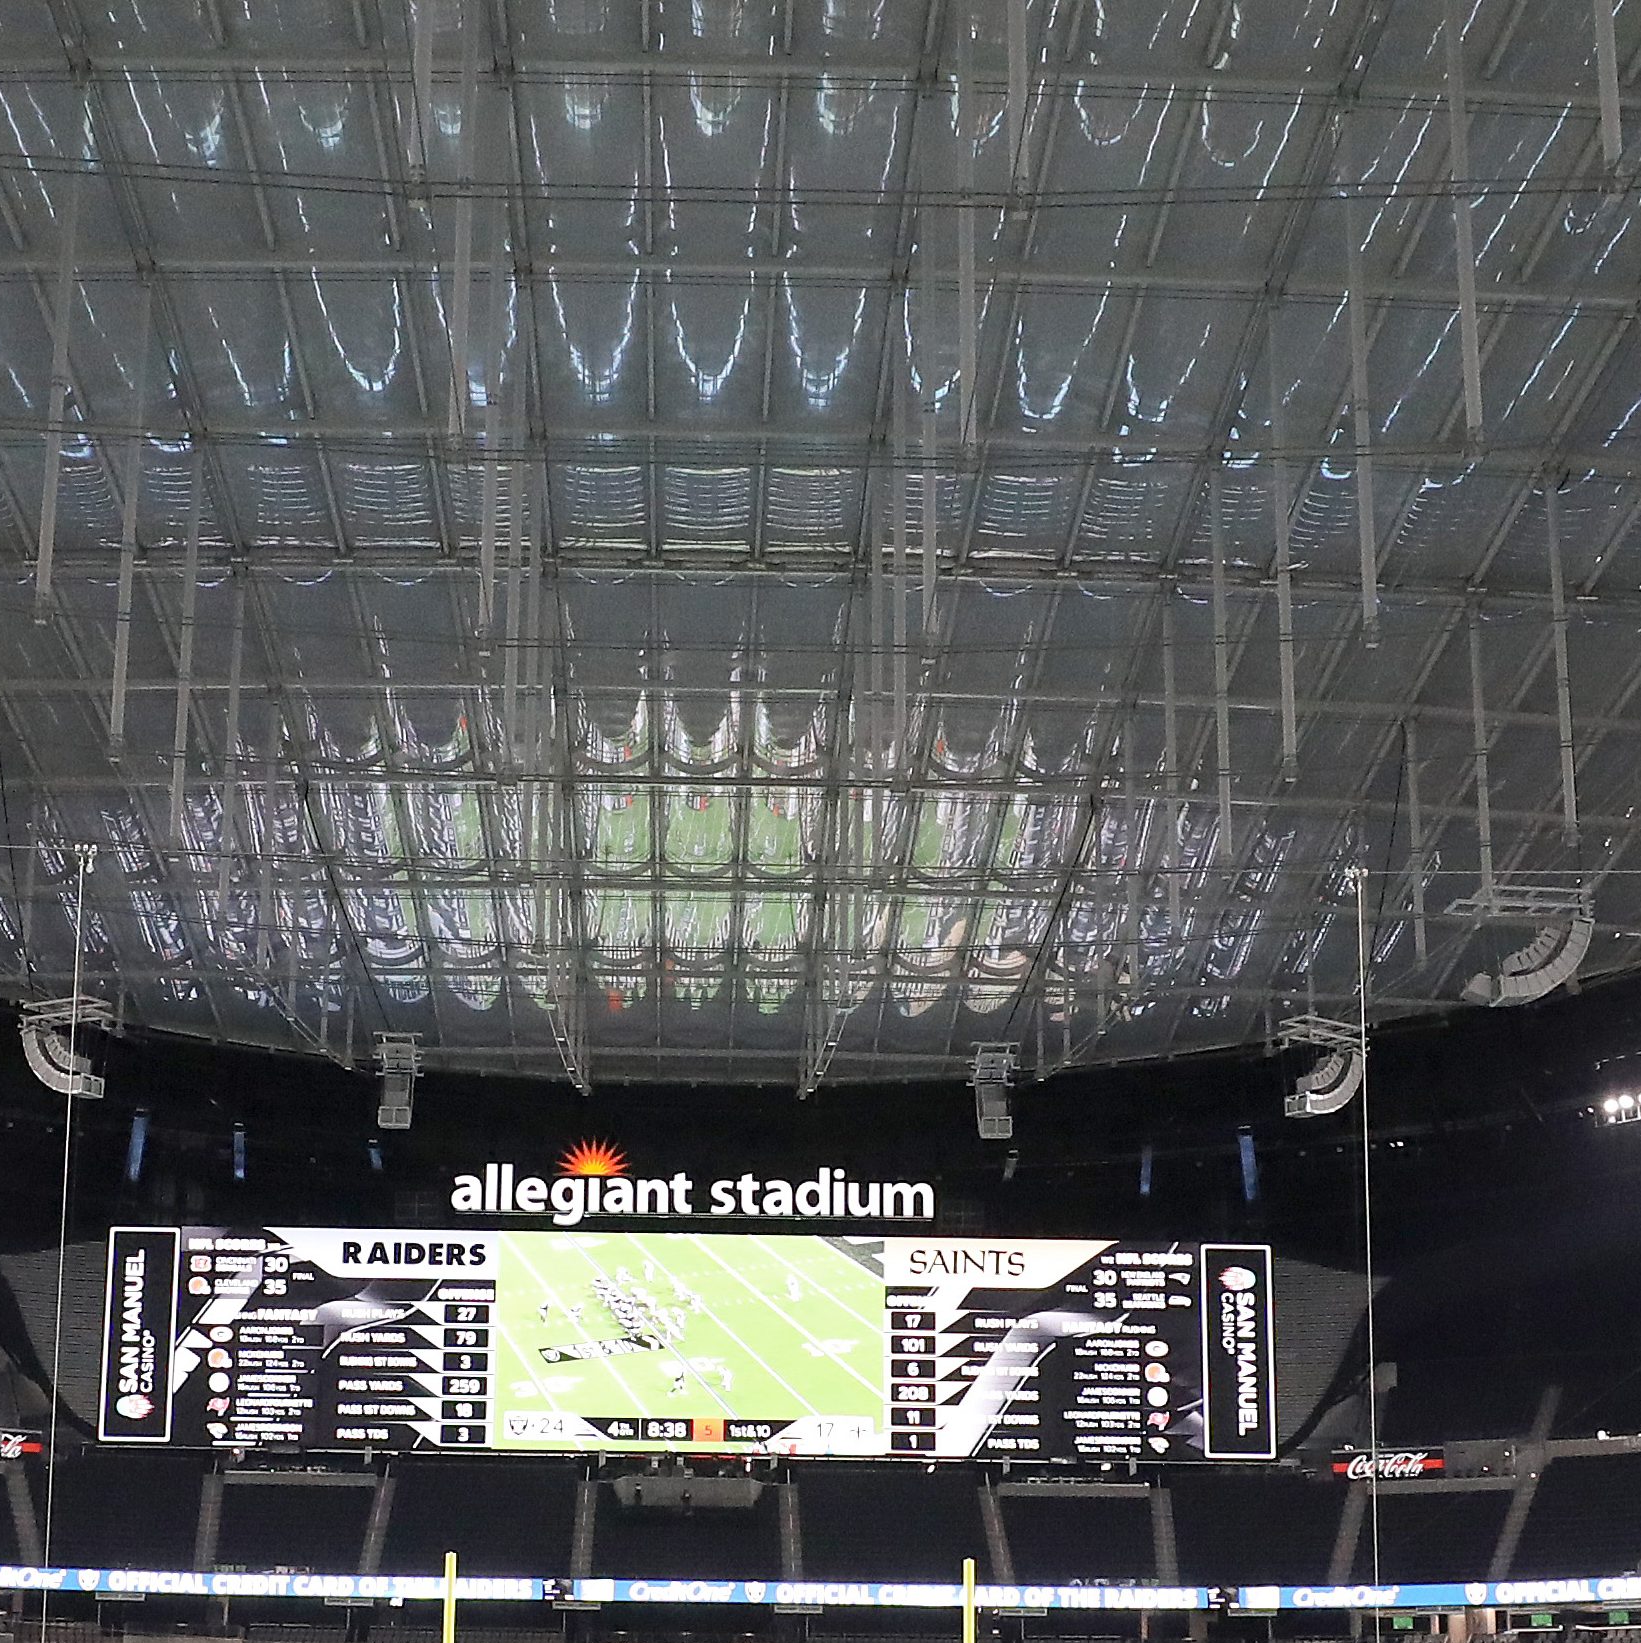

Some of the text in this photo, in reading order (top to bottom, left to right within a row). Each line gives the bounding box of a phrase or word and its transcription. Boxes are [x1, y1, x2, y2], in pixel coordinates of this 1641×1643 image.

[450, 1163, 935, 1225] allegiant stadium
[343, 1241, 487, 1267] RAIDERS
[263, 1256, 289, 1273] 30
[909, 1249, 1026, 1277] SAINTS
[292, 1272, 315, 1281] FINAL
[1092, 1269, 1117, 1286] 30
[263, 1279, 288, 1295] 35
[1065, 1284, 1089, 1293] FINAL
[1093, 1292, 1117, 1308] 35
[118, 1248, 146, 1393] SAN MANUEL
[457, 1306, 477, 1321] 27
[904, 1314, 922, 1328] 17
[456, 1331, 477, 1345] 79
[901, 1338, 925, 1352] 101
[460, 1355, 471, 1369] 3
[1235, 1292, 1258, 1437] SAN MANUEL
[449, 1379, 480, 1394] 259
[906, 1410, 921, 1424] 11
[458, 1428, 470, 1442] 3
[541, 1420, 564, 1434] 24
[647, 1421, 687, 1437] 8:38
[704, 1424, 713, 1436] 5
[817, 1421, 834, 1438] 17
[909, 1434, 918, 1448] 1
[108, 1570, 208, 1595] OFFICIAL
[293, 1574, 355, 1598] CARD
[359, 1575, 390, 1599] OF
[1495, 1579, 1596, 1604] OFFICIAL
[776, 1583, 874, 1605] OFFICIAL
[1023, 1587, 1055, 1608] OF
